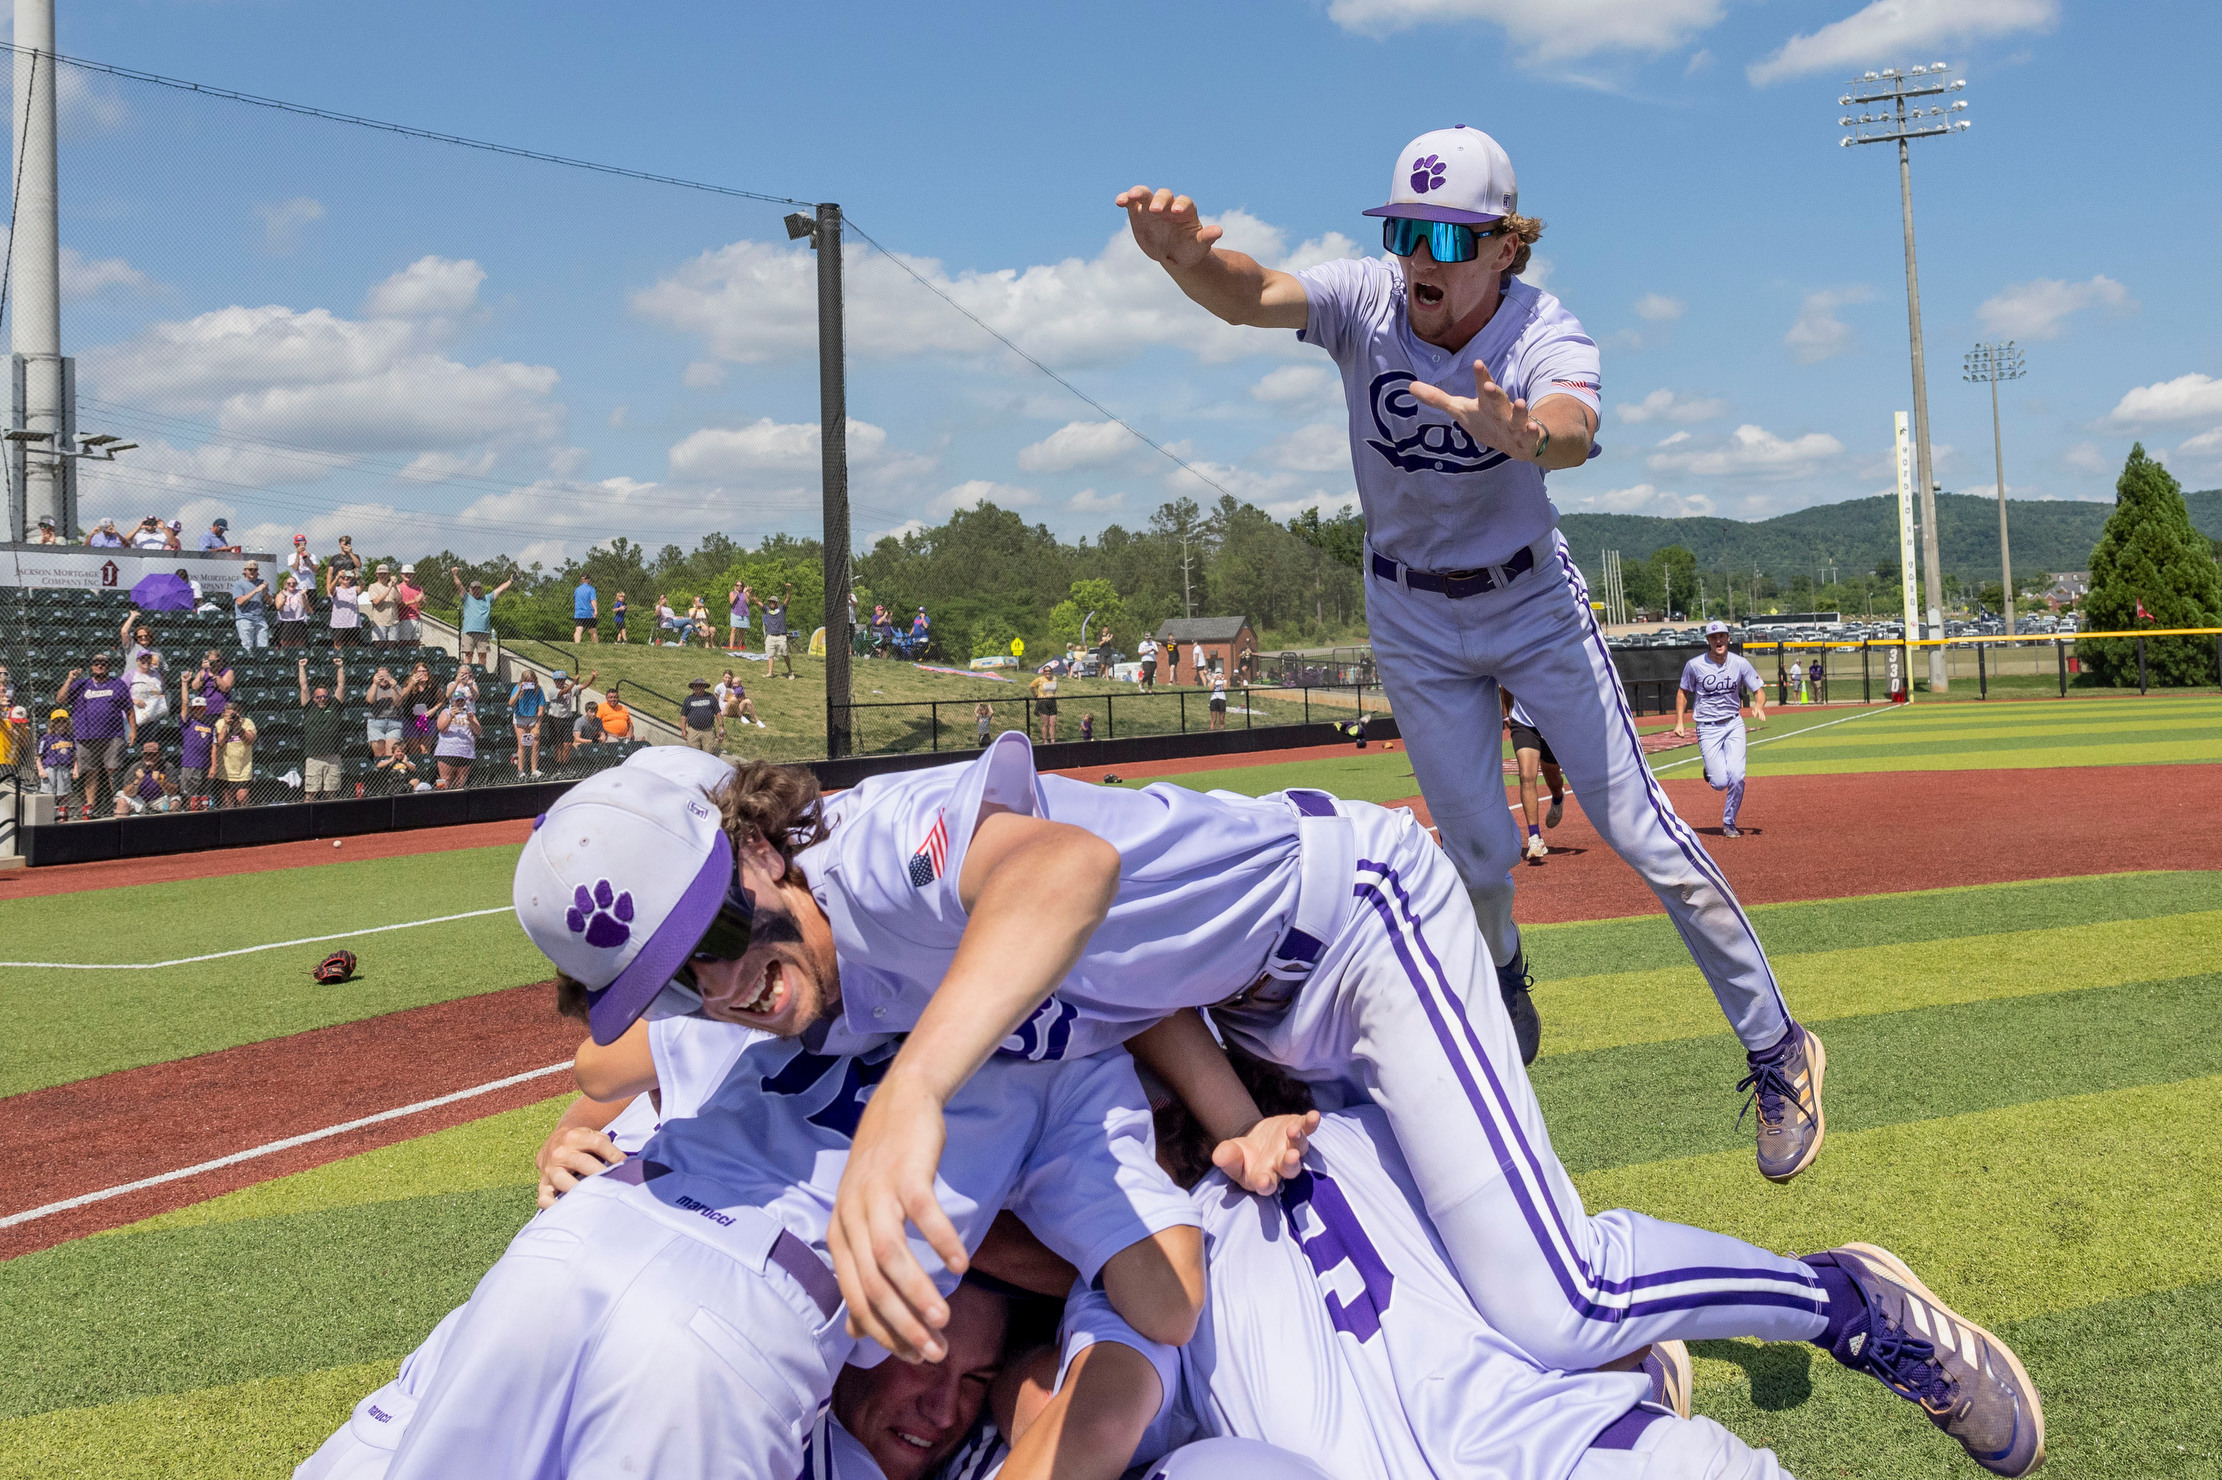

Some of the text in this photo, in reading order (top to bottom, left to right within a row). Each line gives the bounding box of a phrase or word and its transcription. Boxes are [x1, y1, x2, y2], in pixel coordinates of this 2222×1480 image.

[1702, 674, 1738, 694] Cats
[1889, 648, 1900, 693] 330
[675, 1195, 737, 1227] marucci
